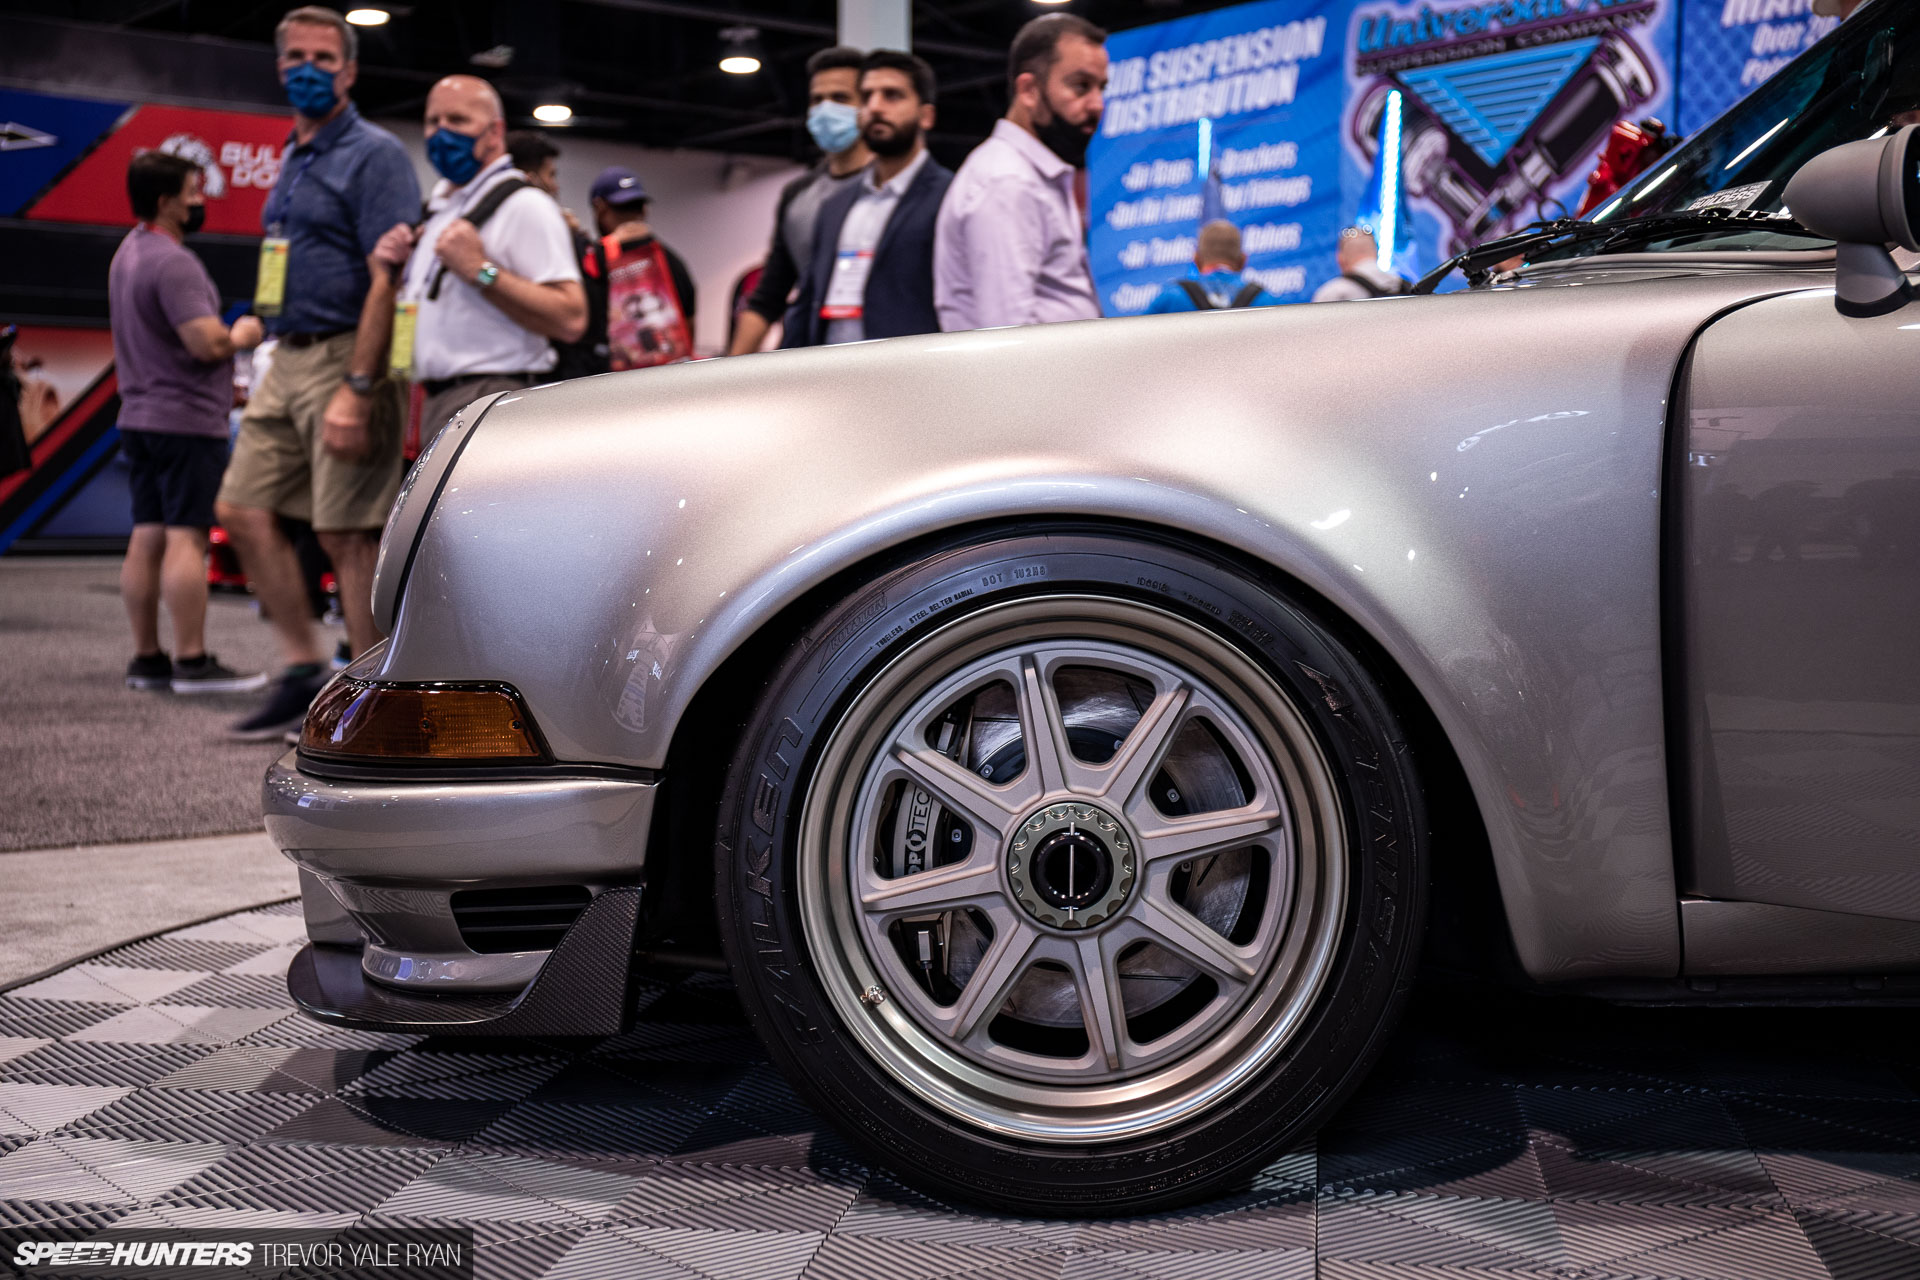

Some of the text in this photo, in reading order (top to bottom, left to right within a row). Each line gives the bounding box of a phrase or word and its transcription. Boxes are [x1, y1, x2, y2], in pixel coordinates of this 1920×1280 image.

[1147, 16, 1327, 90] SUSPENSION
[1102, 63, 1301, 138] DISTRIBUTION
[222, 141, 281, 167] BUL
[231, 164, 279, 189] DO
[981, 572, 1004, 587] DOT
[875, 587, 976, 648] TUBELESS STEEL BELTED RADIAL
